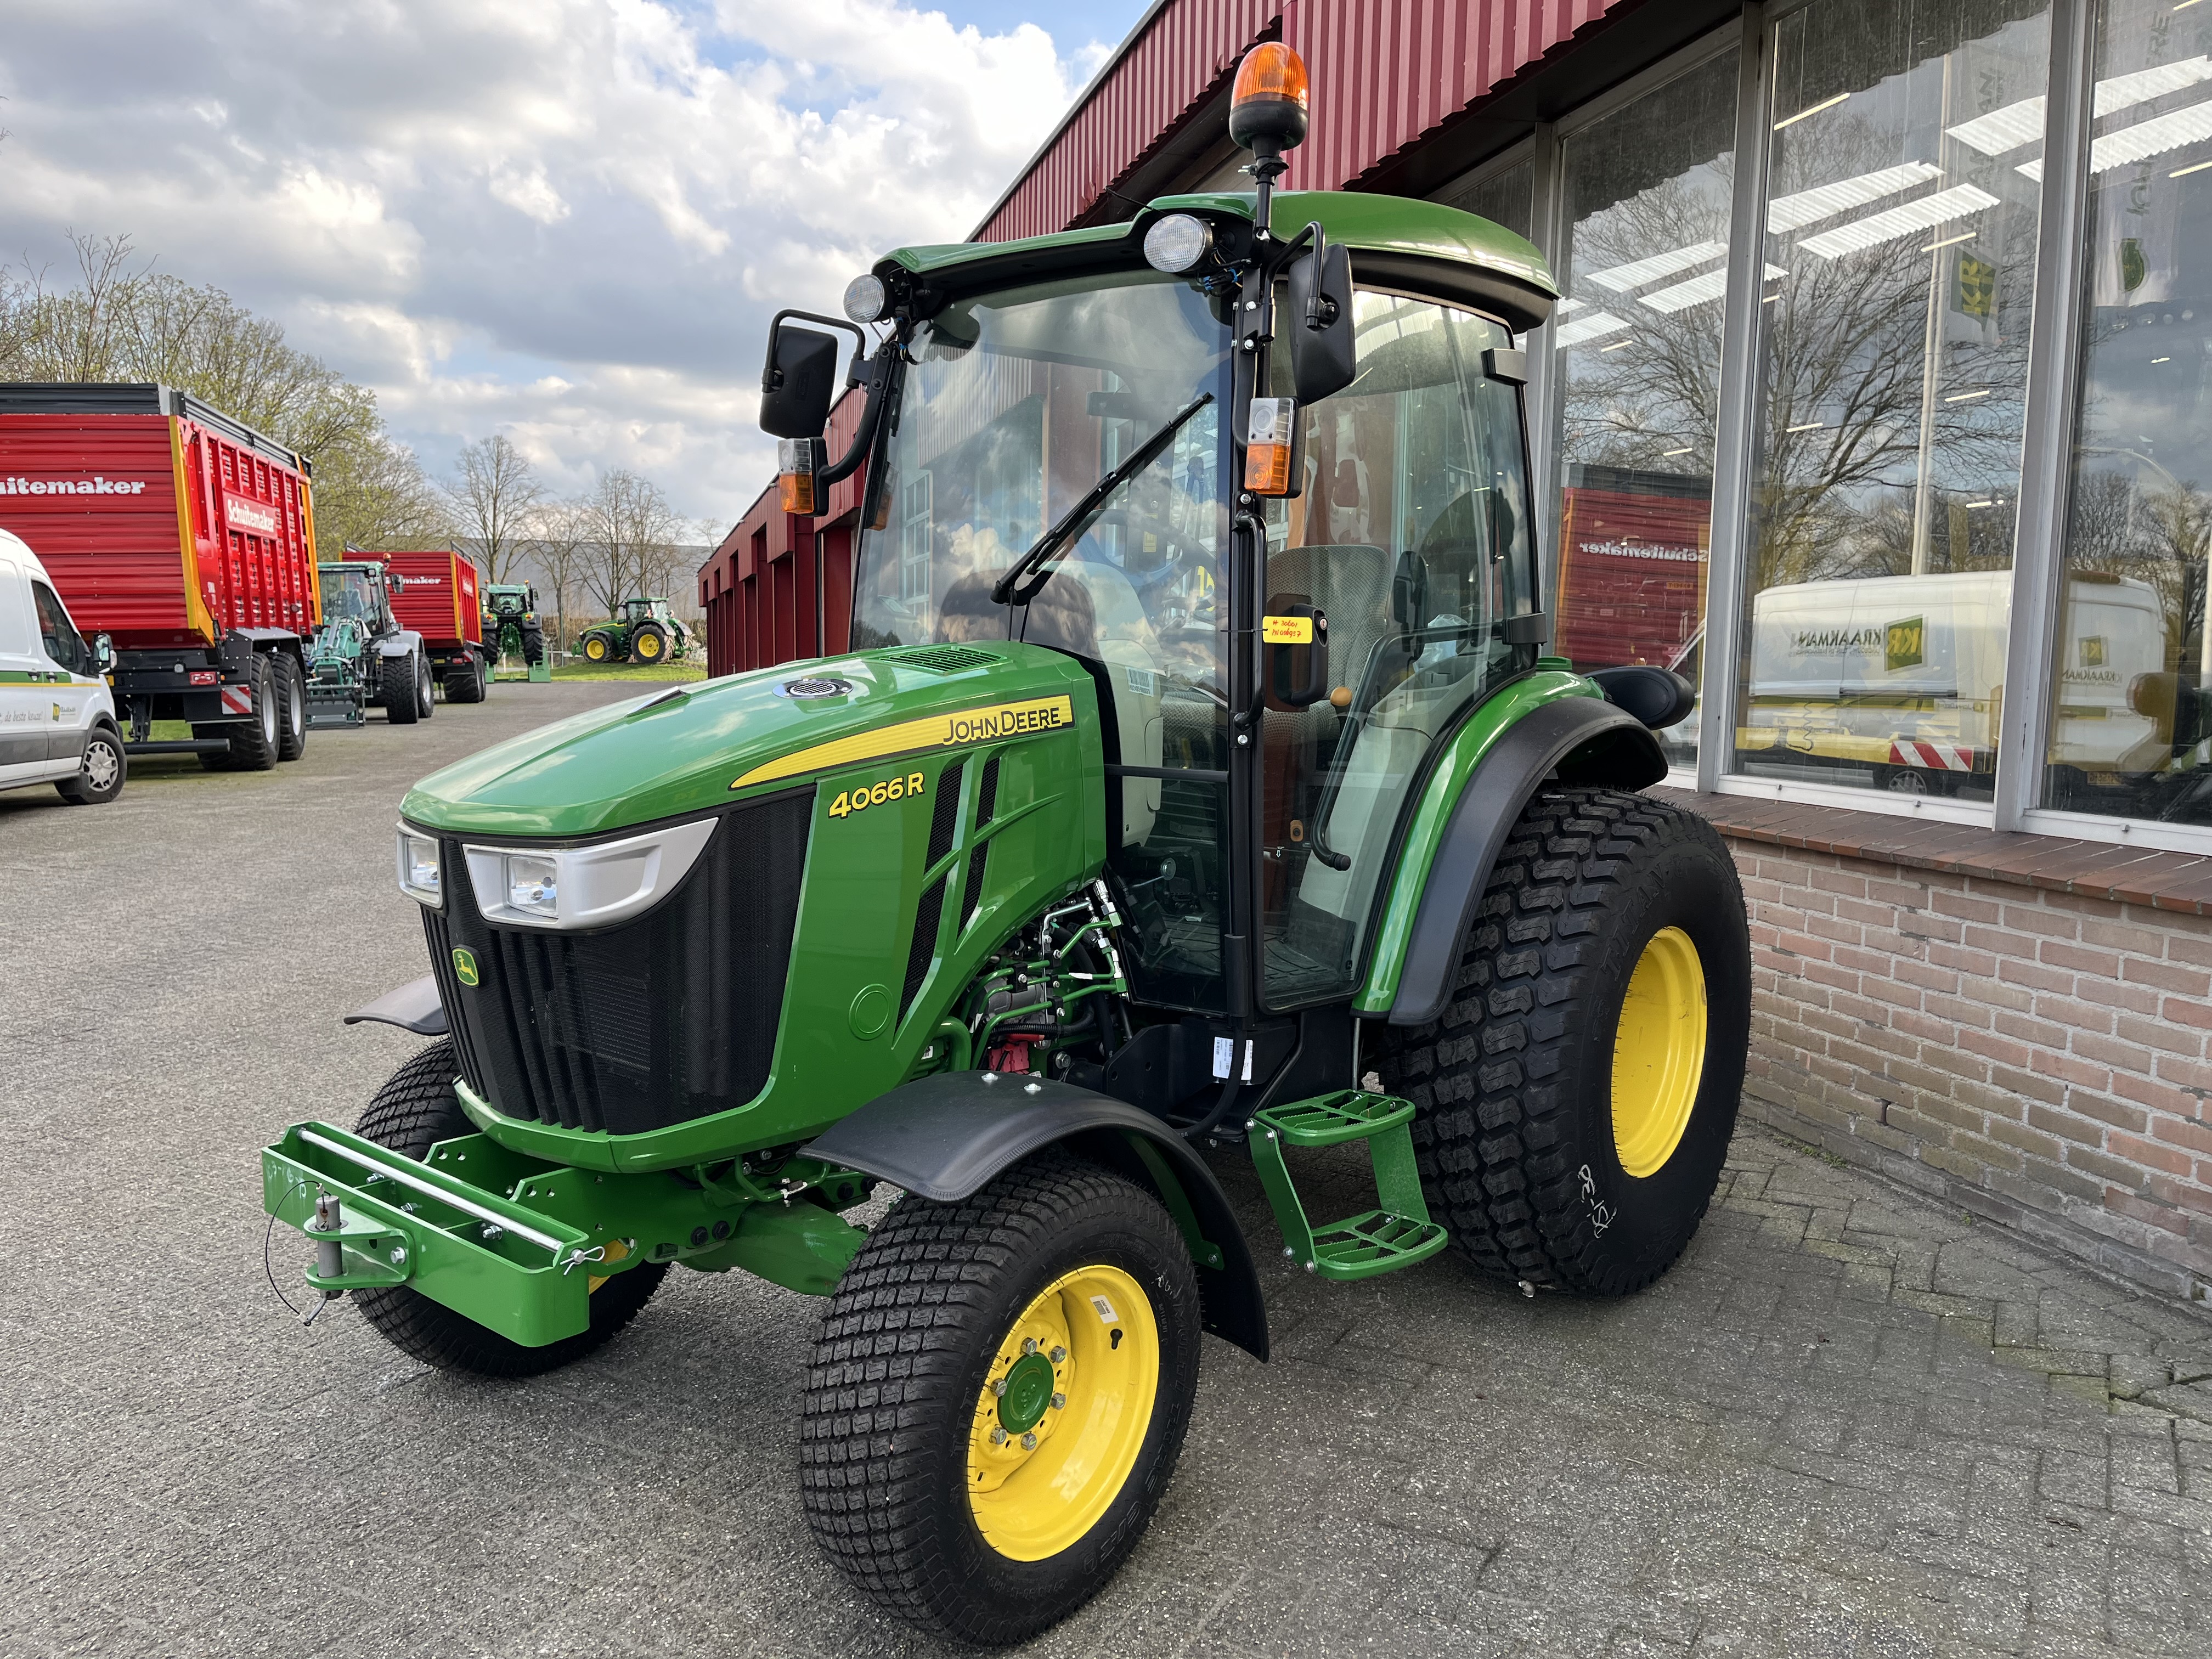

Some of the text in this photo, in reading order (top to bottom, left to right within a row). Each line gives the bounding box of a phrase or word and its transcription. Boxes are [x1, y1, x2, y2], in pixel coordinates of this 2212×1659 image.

[228, 499, 274, 533] Schuitemaker
[943, 707, 1059, 744] JOHN DEERE
